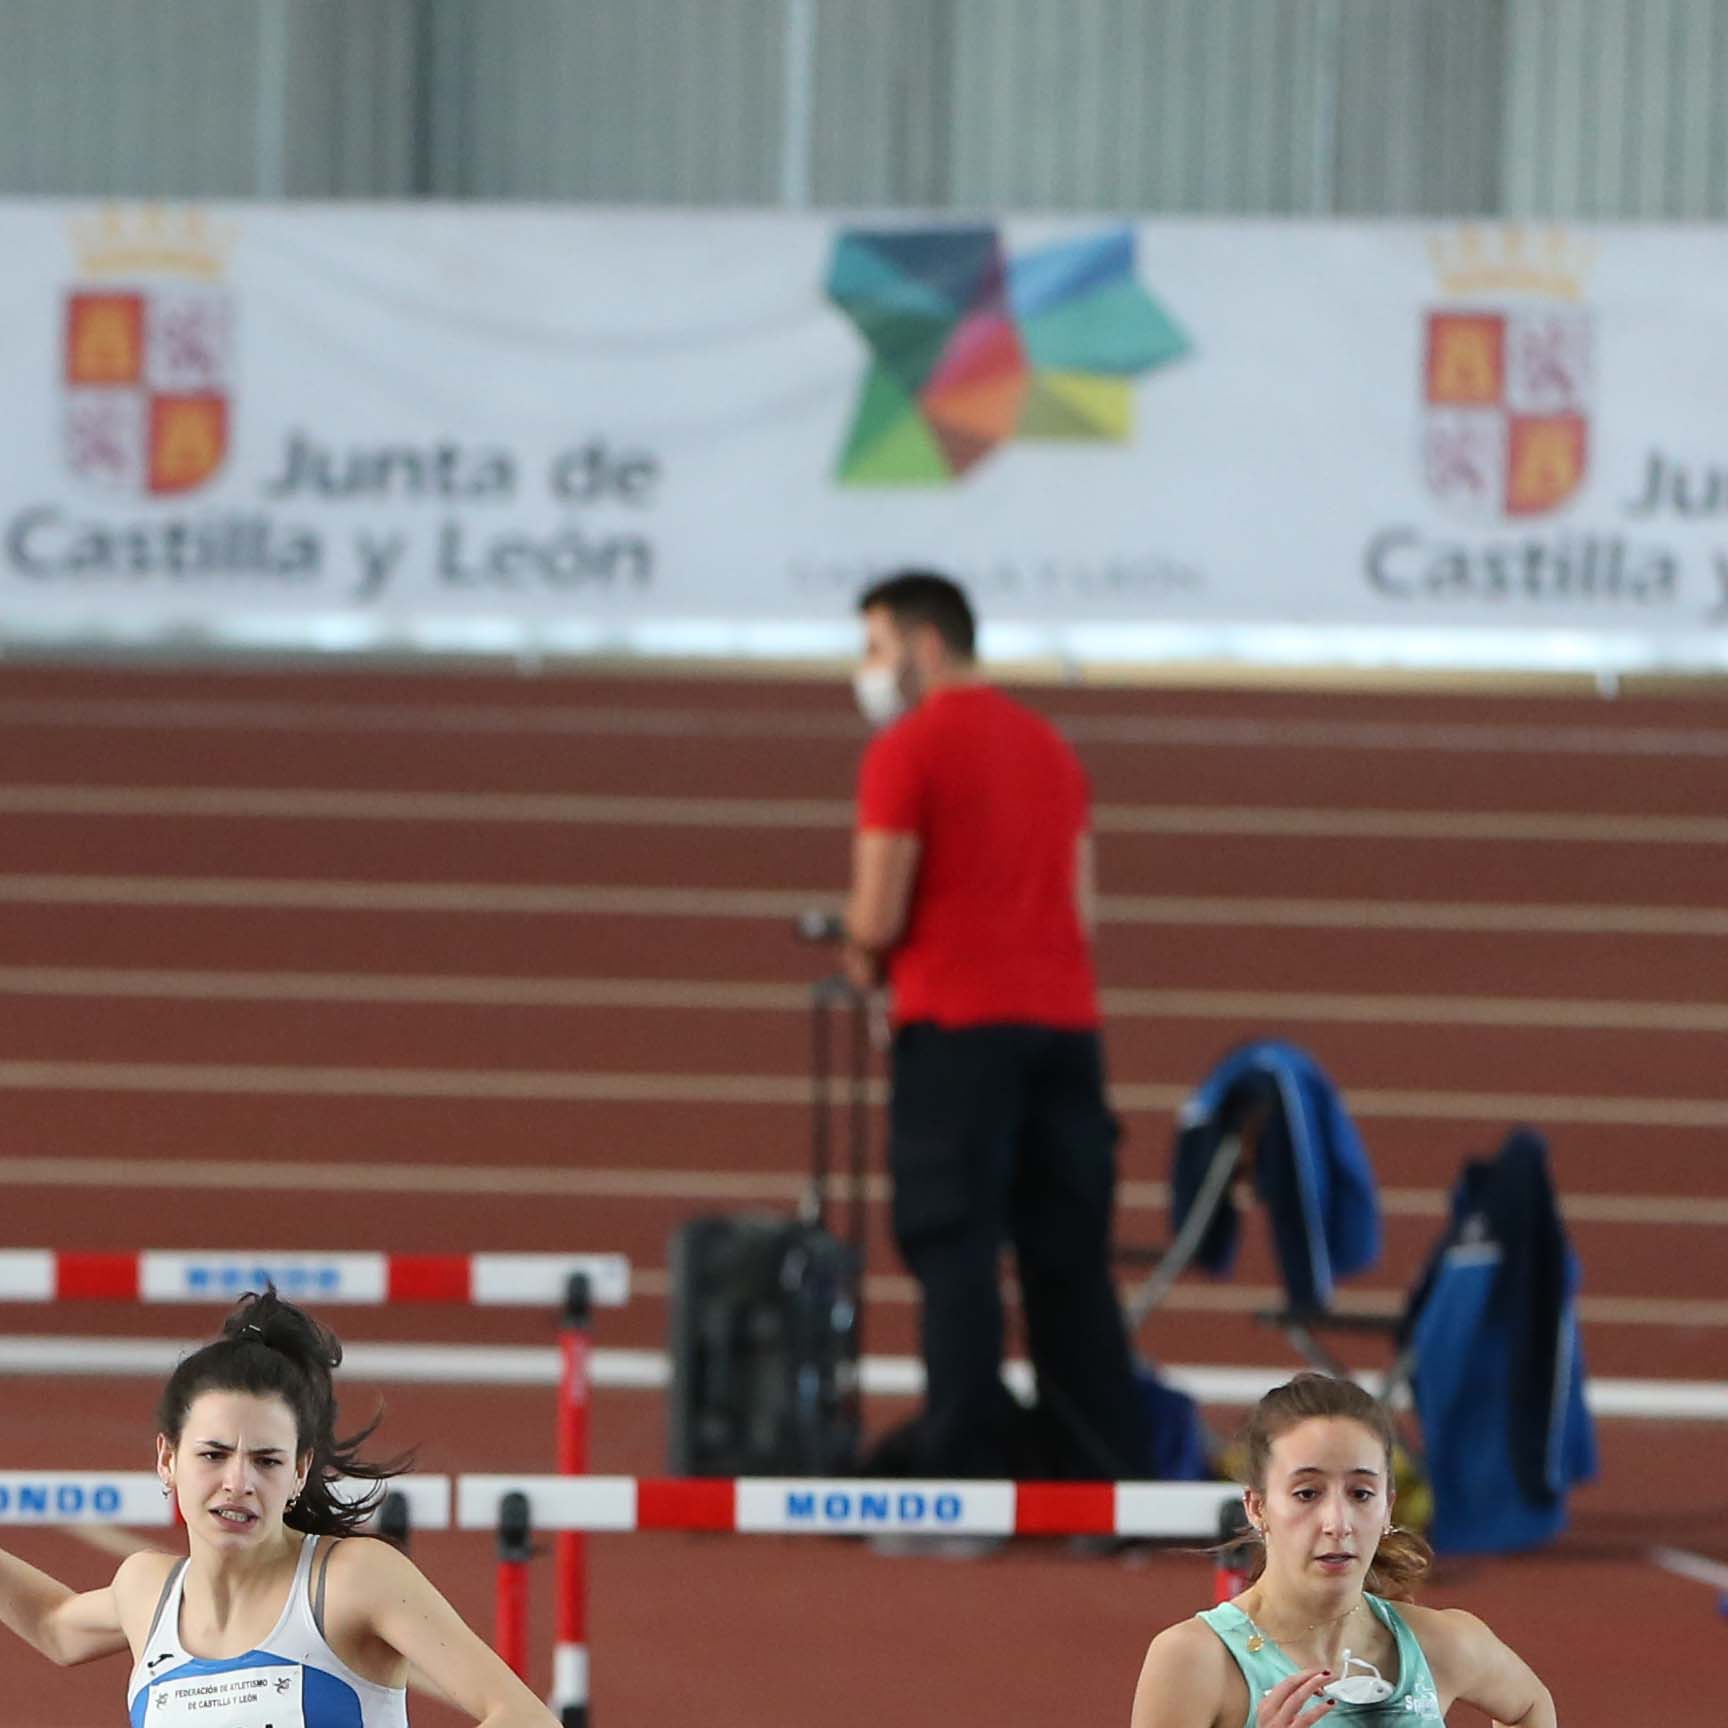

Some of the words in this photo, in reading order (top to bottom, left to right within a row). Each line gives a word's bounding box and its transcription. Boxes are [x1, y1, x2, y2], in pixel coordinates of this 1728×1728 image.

[262, 426, 517, 498] Junta
[551, 436, 661, 504] de
[4, 505, 323, 580] Castilla
[353, 528, 403, 601] y
[438, 519, 657, 589] León
[1361, 525, 1679, 603] Castilla
[786, 1492, 964, 1523] MONDO
[175, 1684, 218, 1700] FEDERACIÓN
[219, 1684, 229, 1694] DE
[229, 1679, 269, 1692] ATLETISMO
[187, 1702, 197, 1711] DE
[198, 1698, 232, 1710] CASTILLA
[238, 1693, 258, 1704] LEÓN
